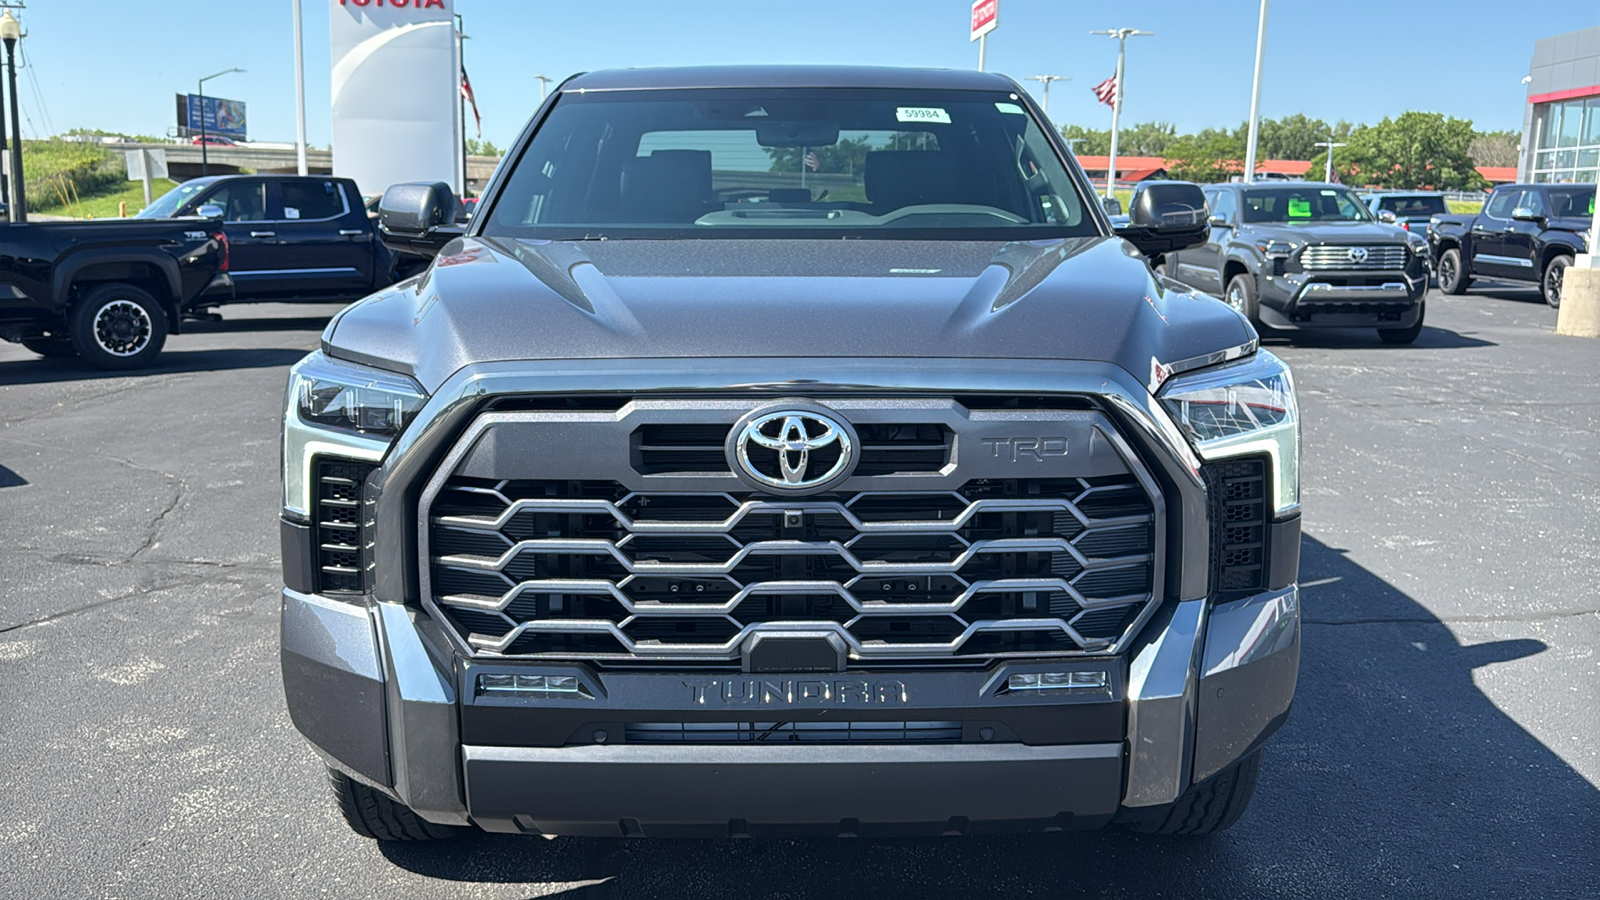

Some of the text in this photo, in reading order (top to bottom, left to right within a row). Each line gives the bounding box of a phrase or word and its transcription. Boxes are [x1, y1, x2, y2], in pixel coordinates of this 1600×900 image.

[905, 109, 940, 119] 59984
[184, 231, 207, 239] TRD
[981, 437, 1068, 462] TRD
[682, 680, 908, 704] TUNDRA
